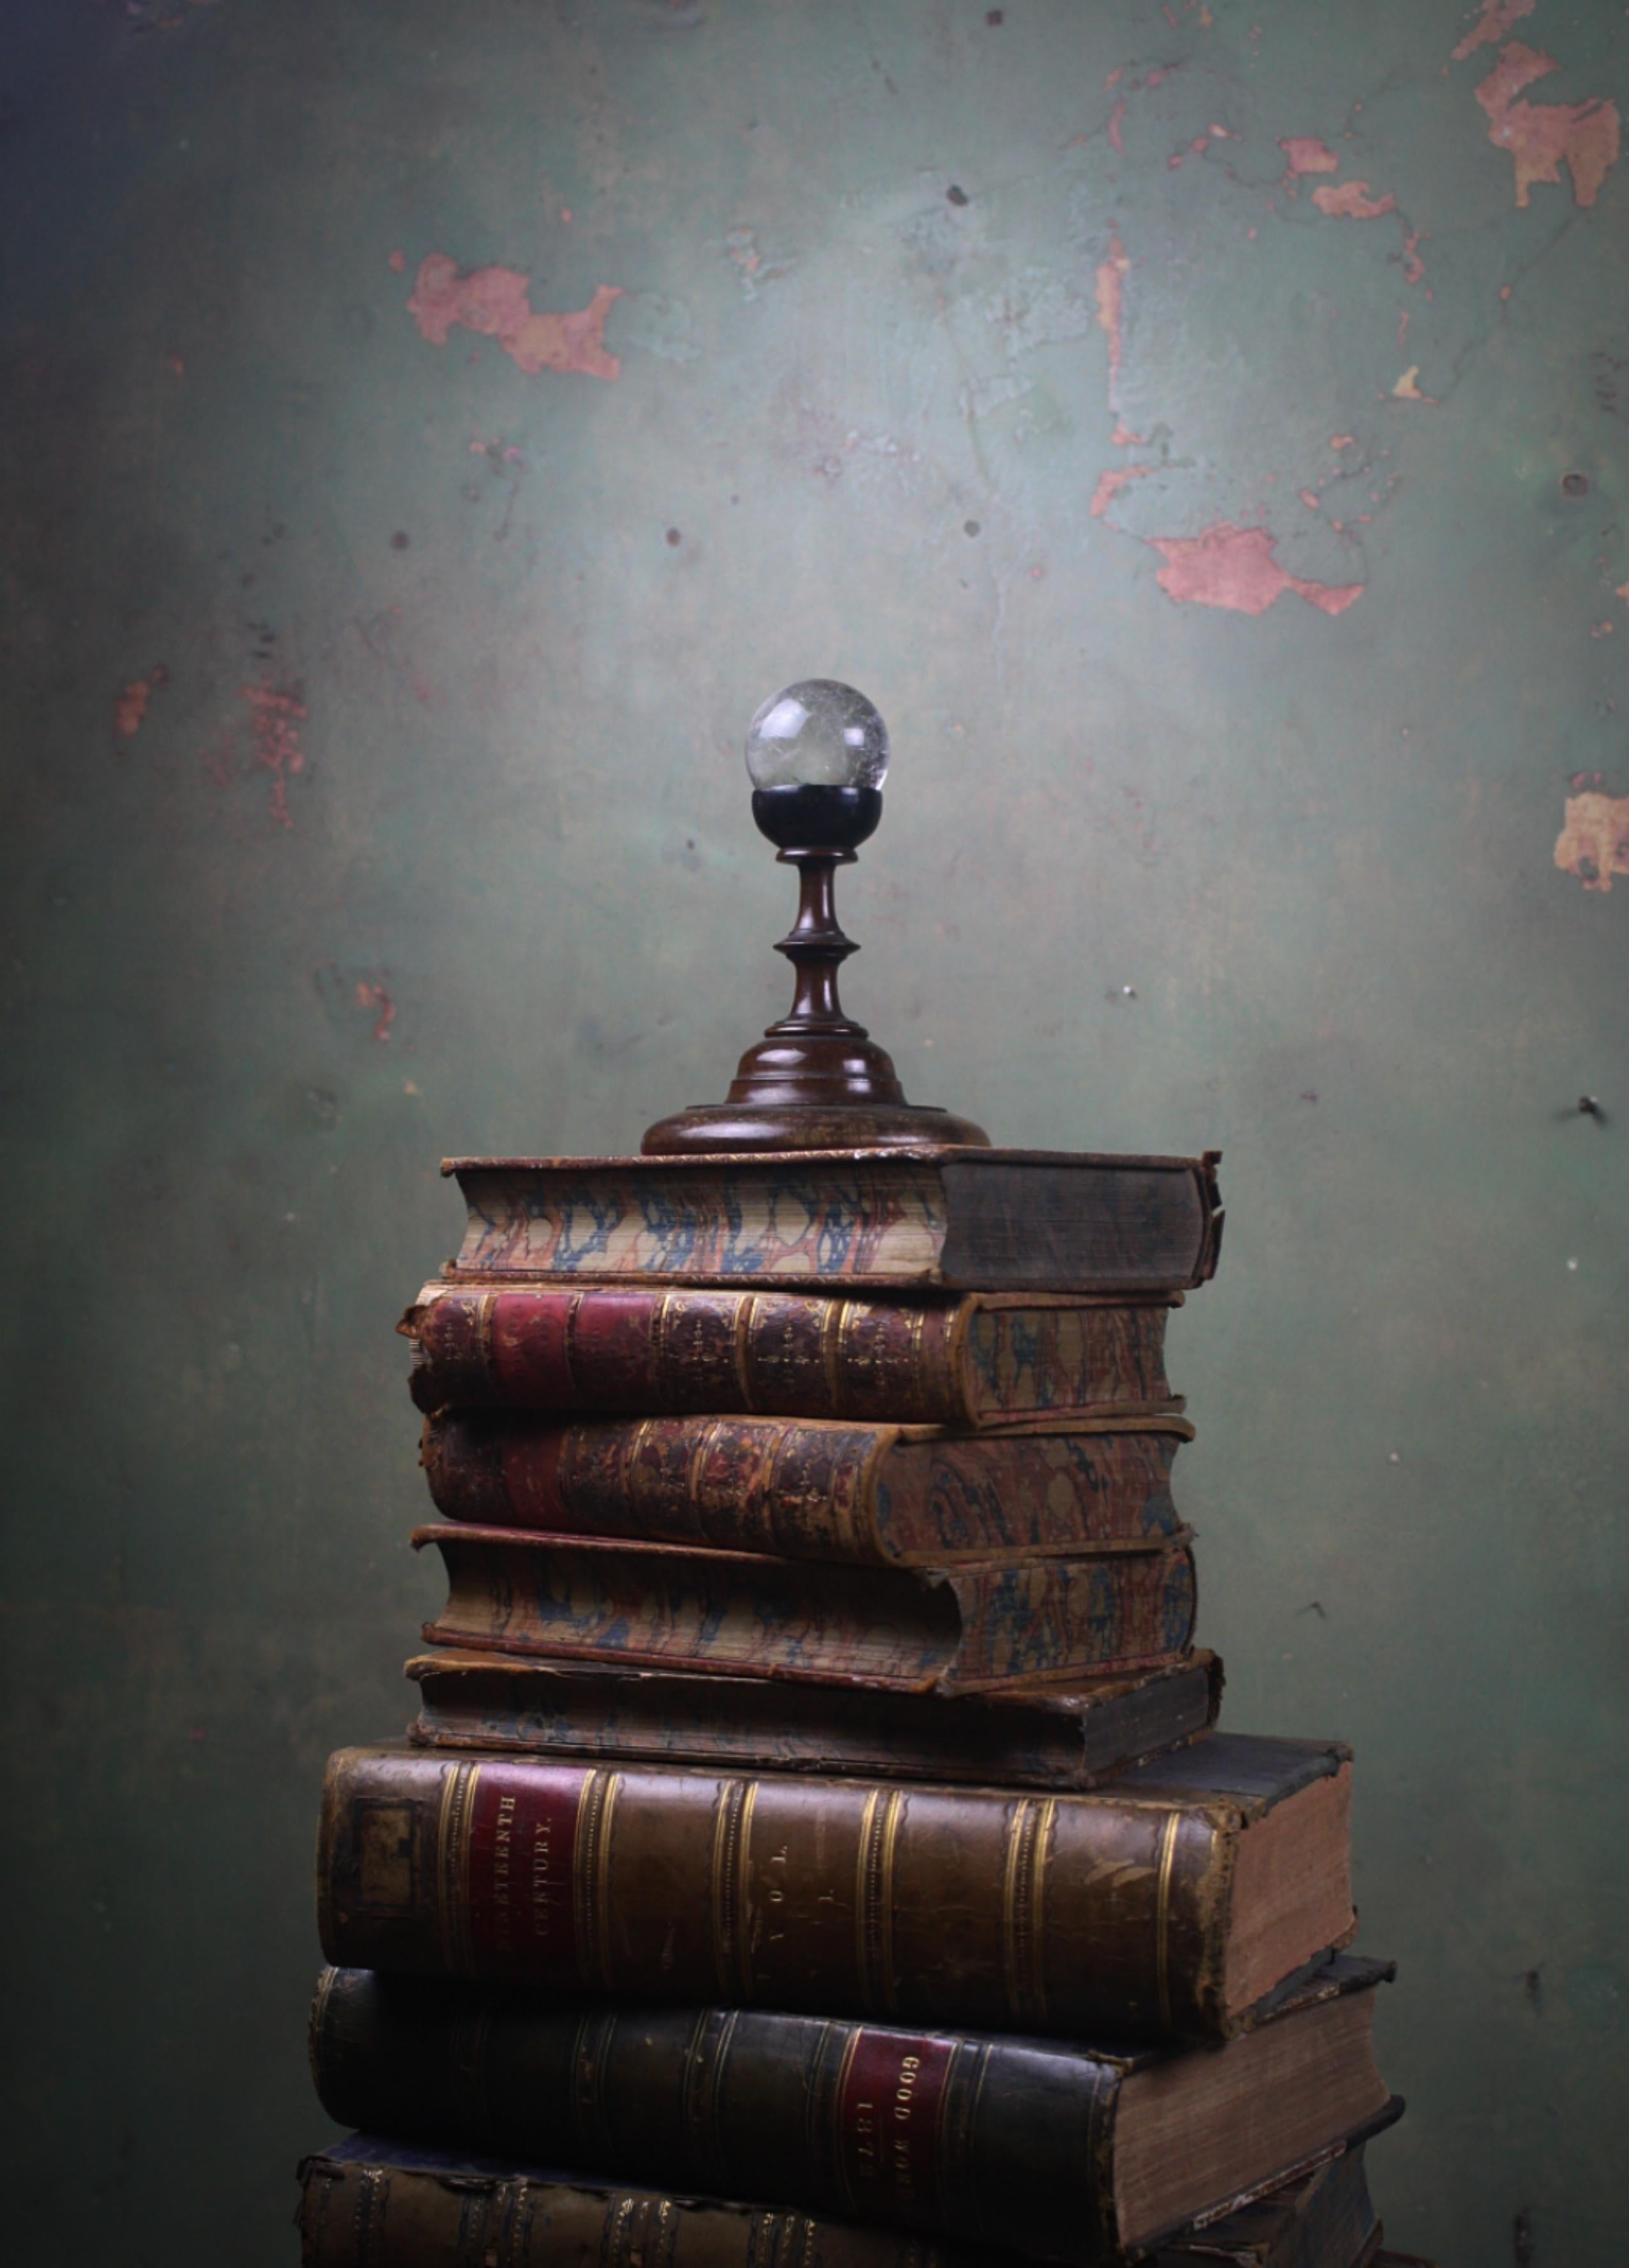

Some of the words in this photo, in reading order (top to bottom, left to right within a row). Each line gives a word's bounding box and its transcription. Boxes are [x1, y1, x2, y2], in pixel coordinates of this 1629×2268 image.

[494, 1796, 516, 1951] NINETEENTH
[531, 1818, 552, 1935] CENTURY.
[895, 2056, 920, 2121] GOOD
